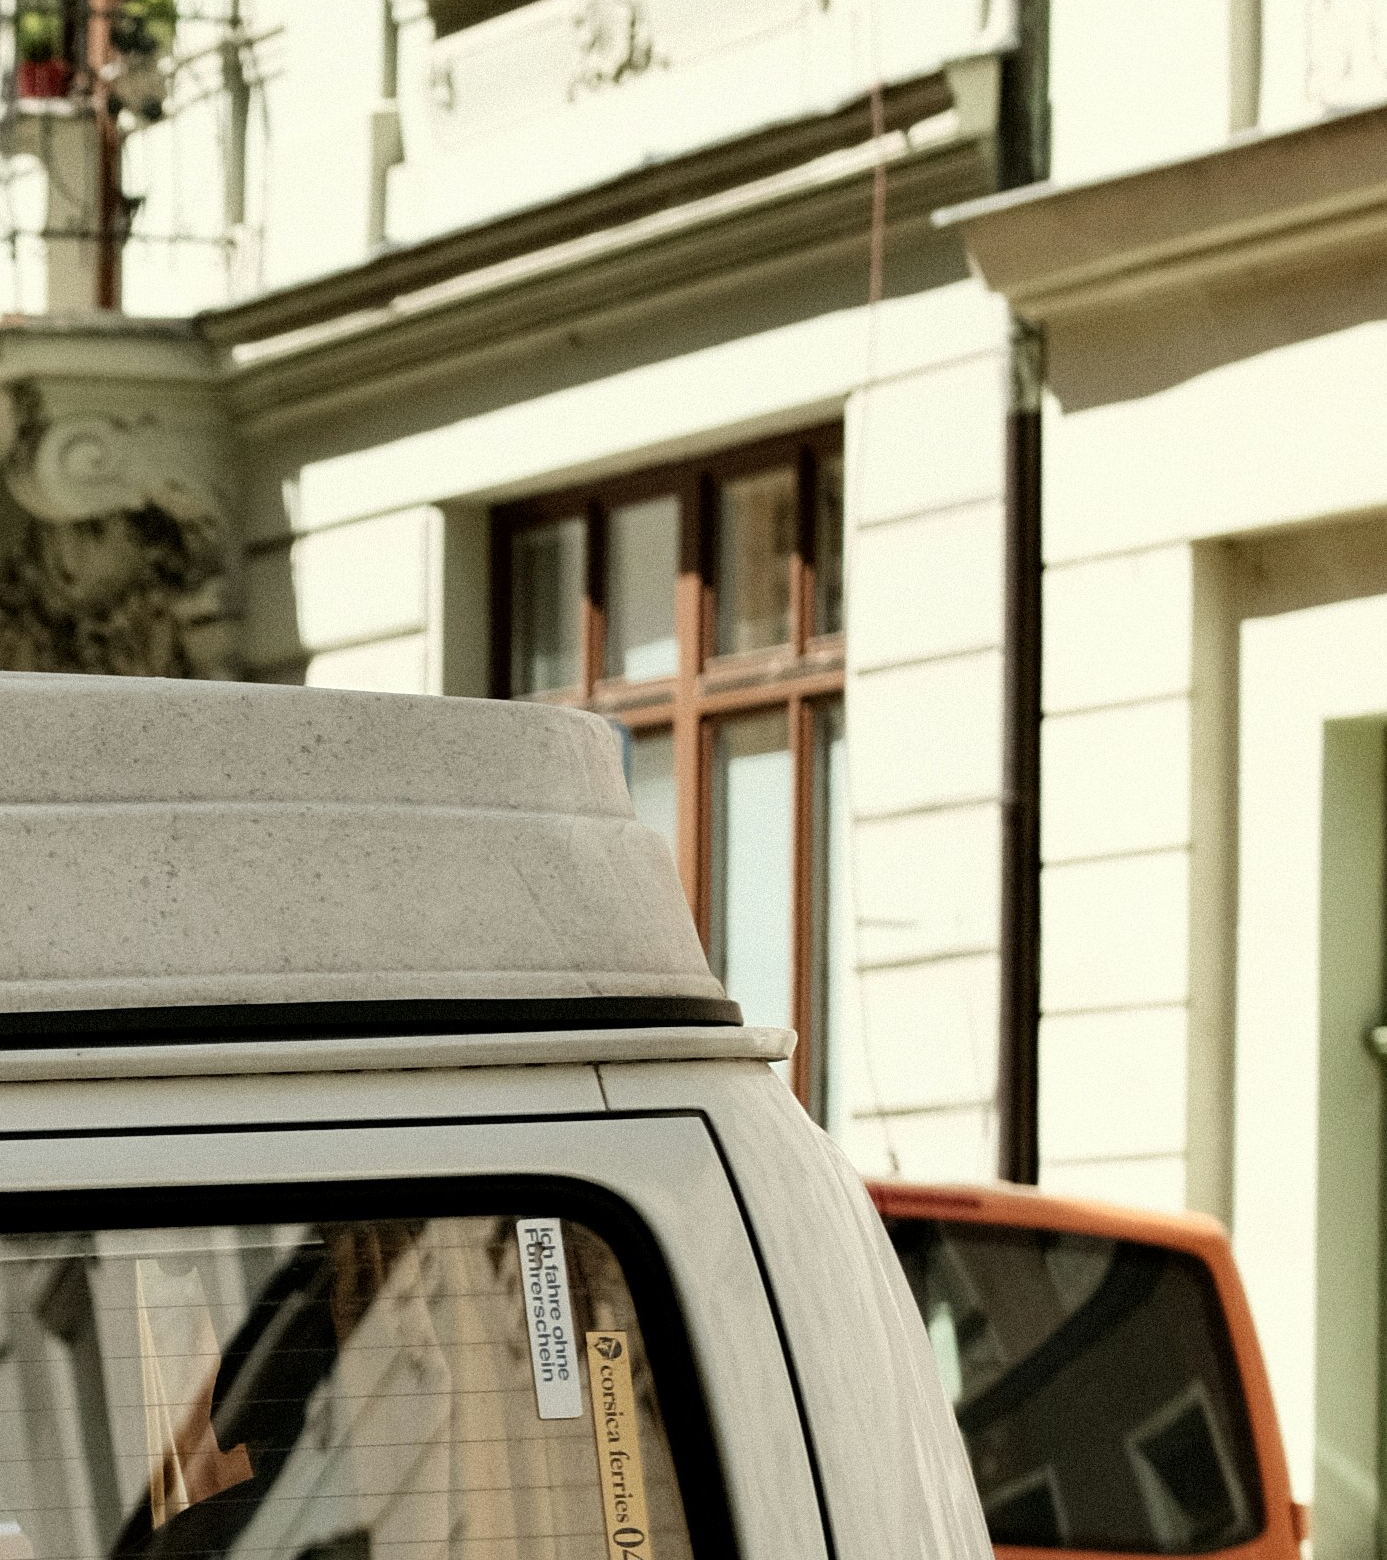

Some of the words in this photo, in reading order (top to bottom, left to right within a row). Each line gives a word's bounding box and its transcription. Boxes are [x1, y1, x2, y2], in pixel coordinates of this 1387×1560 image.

[539, 1227, 556, 1259] ich
[544, 1263, 562, 1321] fahre
[552, 1325, 570, 1381] ohne
[599, 1364, 624, 1444] corsica
[608, 1448, 633, 1524] ferries
